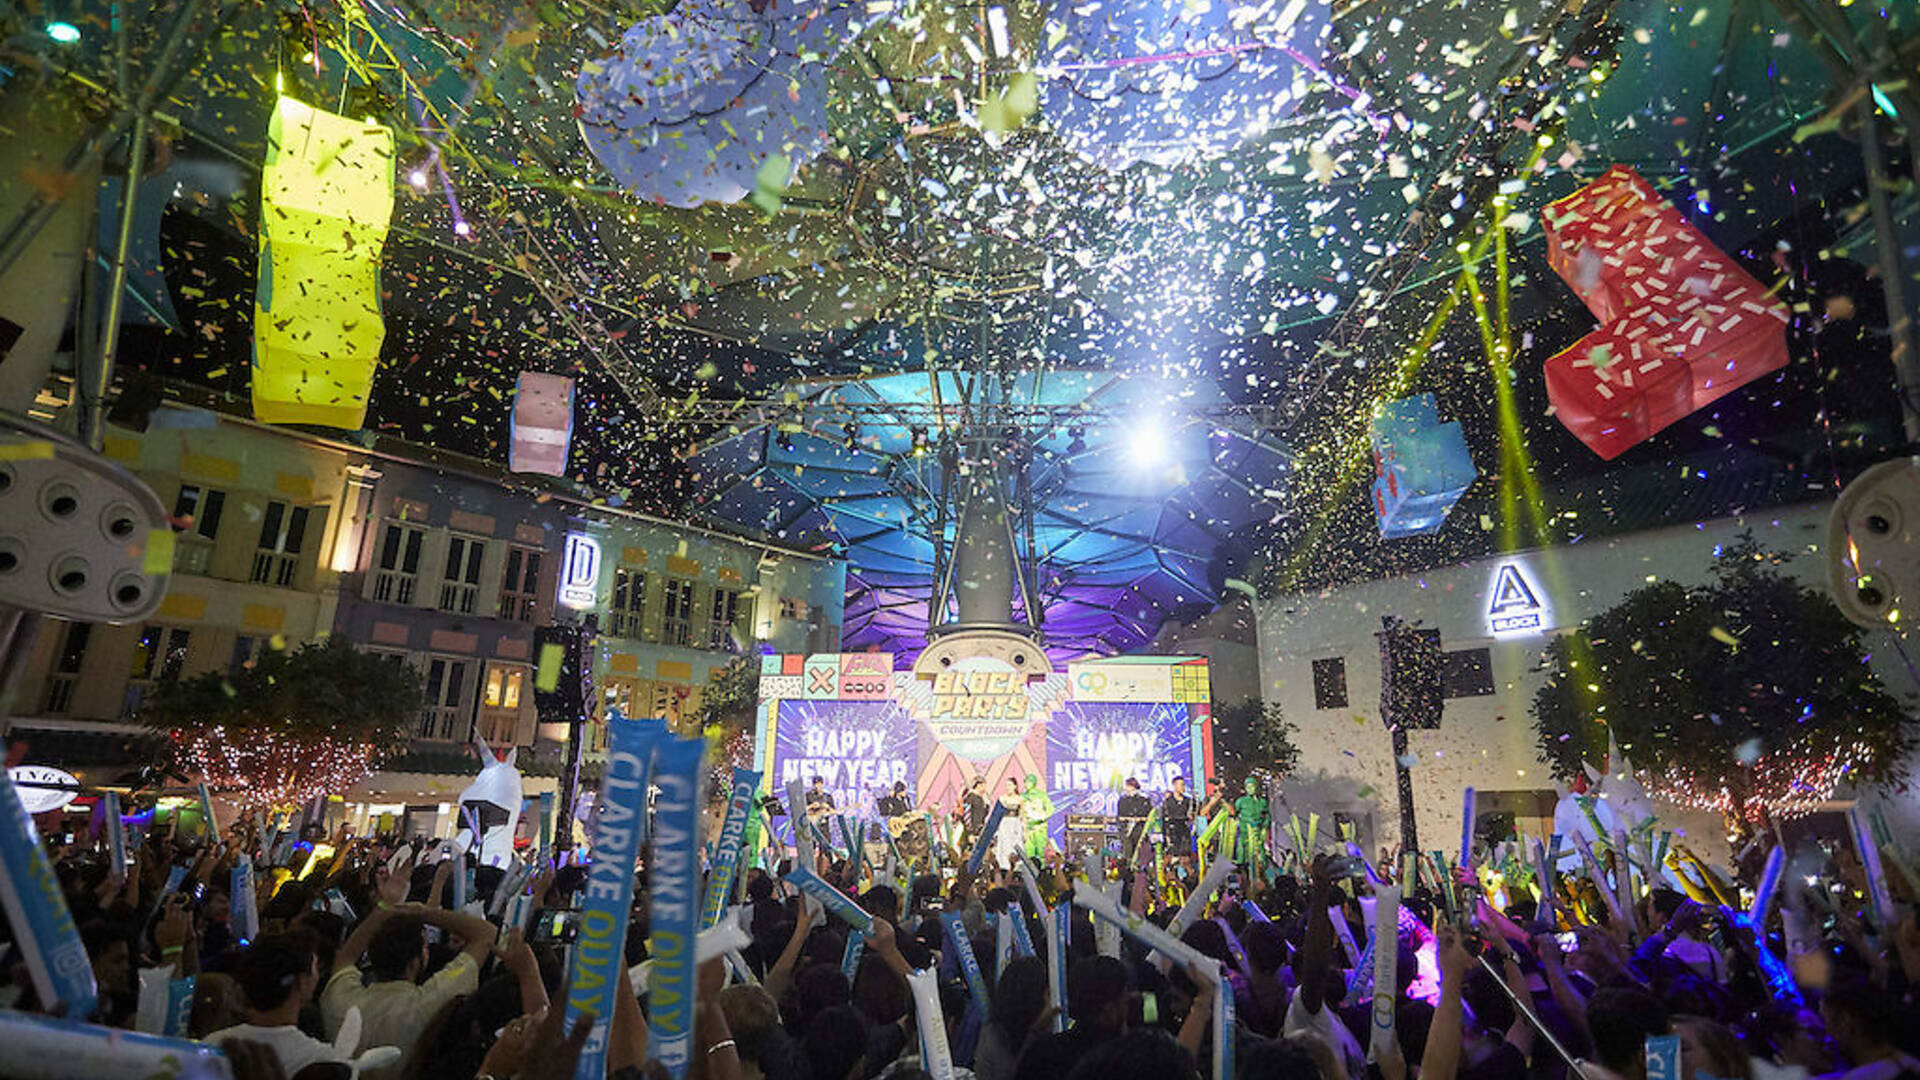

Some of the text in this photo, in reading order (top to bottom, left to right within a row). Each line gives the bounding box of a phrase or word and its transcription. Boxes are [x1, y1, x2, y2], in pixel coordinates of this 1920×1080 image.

[566, 536, 597, 587] D
[1489, 564, 1540, 614] A
[1494, 616, 1538, 631] BLOCK
[932, 671, 1030, 694] BLOCK
[930, 693, 1031, 720] PARTY
[806, 727, 889, 758] HAPPY
[940, 724, 1025, 736] COUNTDOWN
[1077, 730, 1160, 761] HAPPY
[782, 758, 908, 789] NEW YEAR
[588, 751, 644, 901] CLARKE
[709, 782, 753, 863] CLARKE
[650, 773, 693, 1033] CLARKE QUAY
[569, 909, 616, 1019] QUAY
[951, 919, 978, 974] CLARKE
